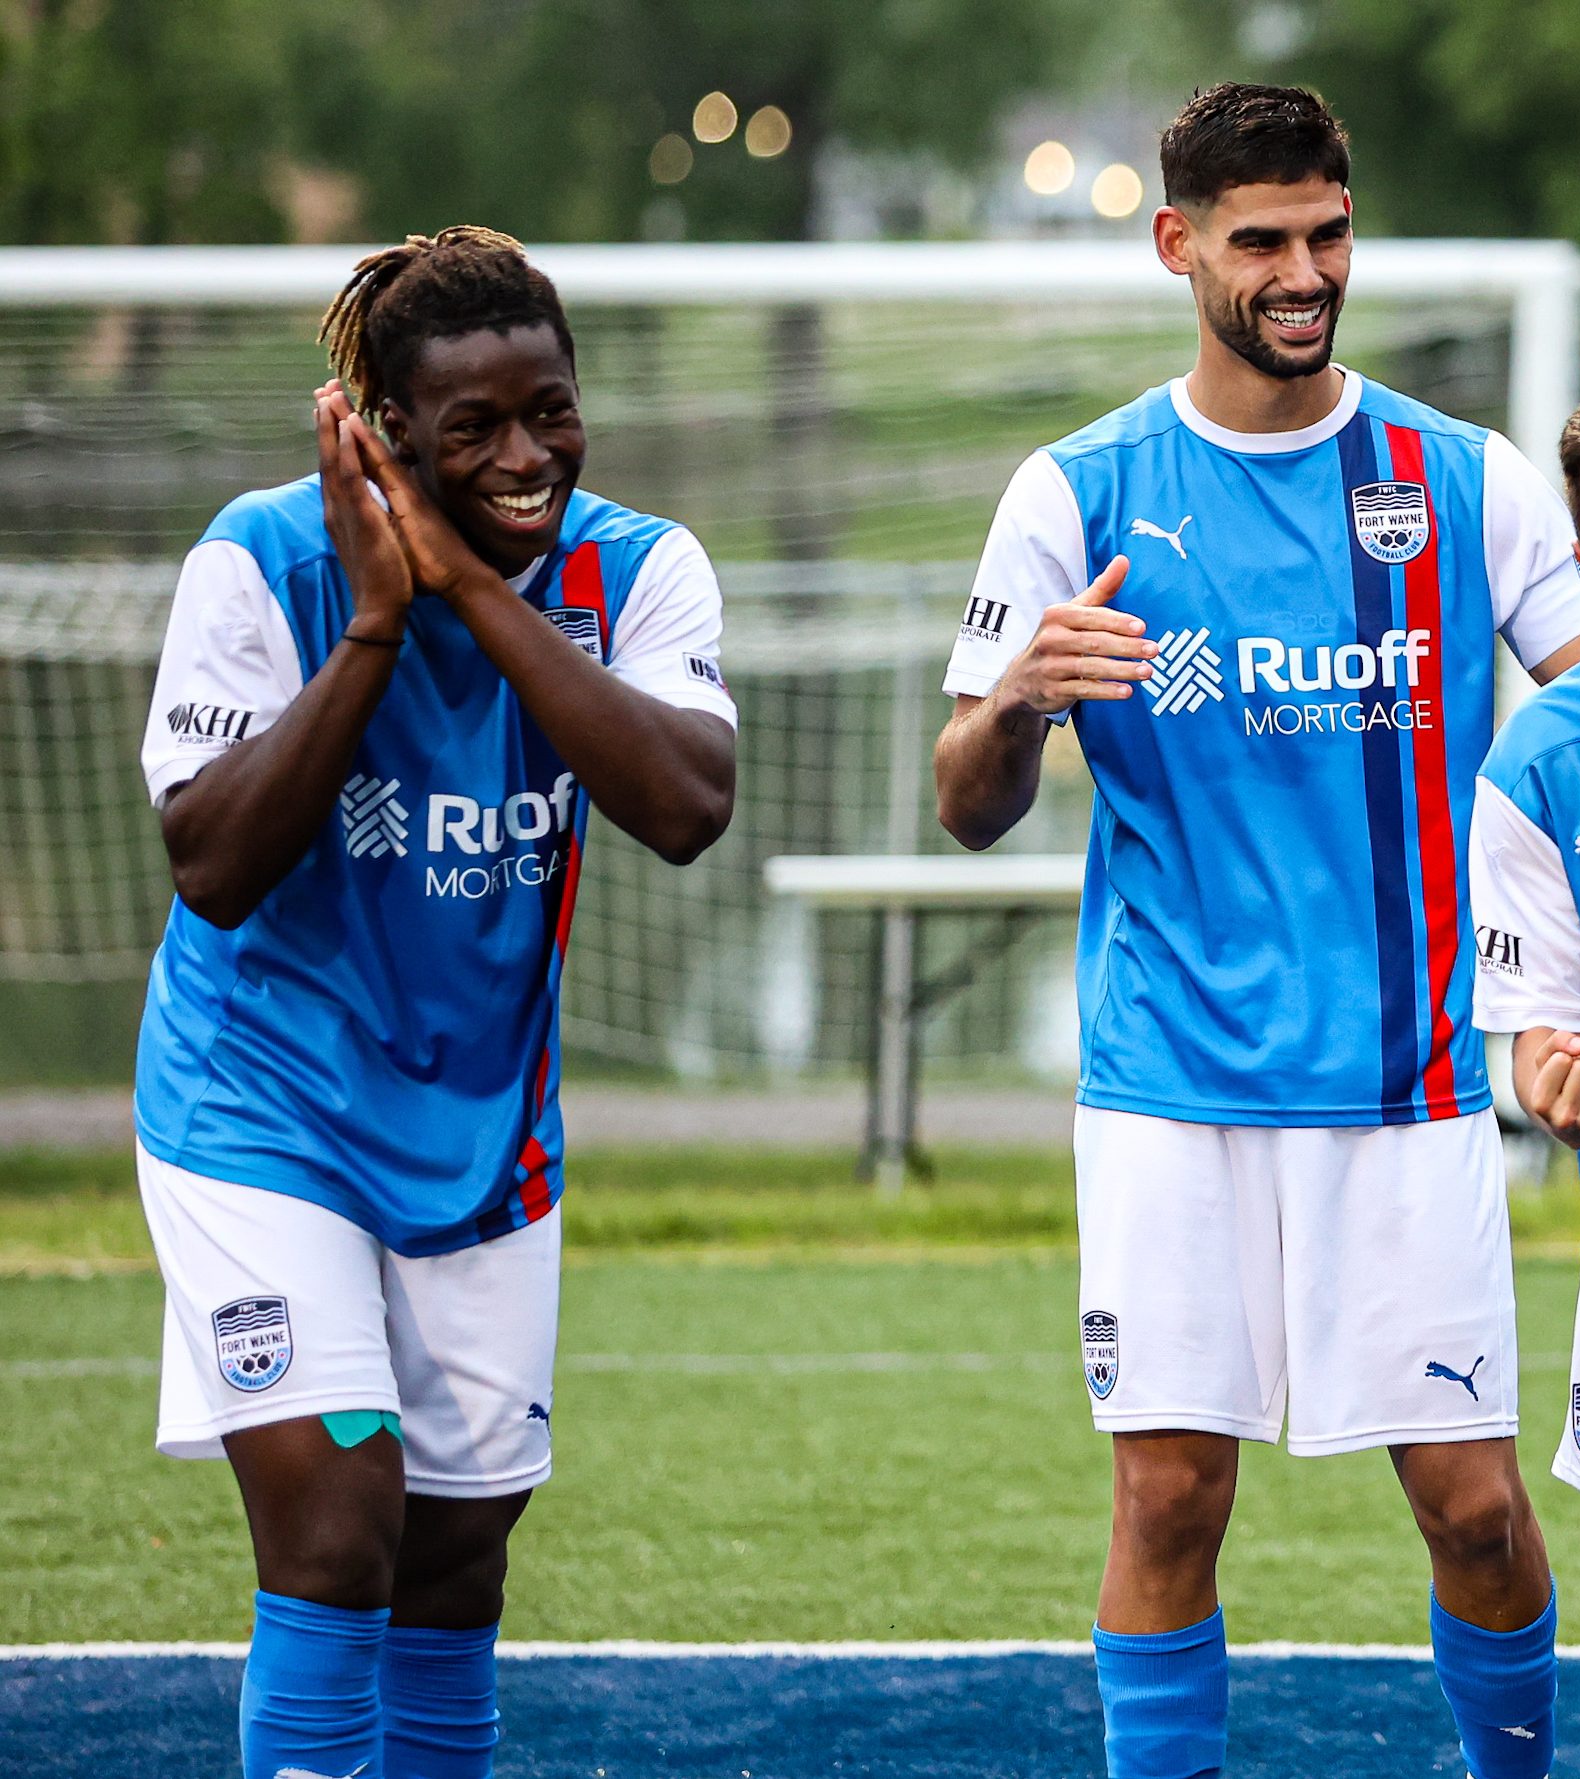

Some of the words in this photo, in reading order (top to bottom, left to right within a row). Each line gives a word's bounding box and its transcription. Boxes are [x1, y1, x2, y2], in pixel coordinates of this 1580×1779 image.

[1359, 515, 1385, 528] FORT
[1388, 513, 1425, 526] WAYNE
[1369, 543, 1404, 559] FOOTBALL
[1404, 540, 1421, 555] CLUB
[961, 596, 1012, 634] HI
[1237, 629, 1431, 694] Ruoff
[183, 703, 257, 741] KHI
[1244, 700, 1434, 737] MORTGAGE
[427, 771, 576, 855] Ruof
[222, 1338, 246, 1354] FORT
[249, 1331, 287, 1348] WAYNE
[1086, 1347, 1097, 1359] FORT
[1098, 1347, 1116, 1359] WAYNE
